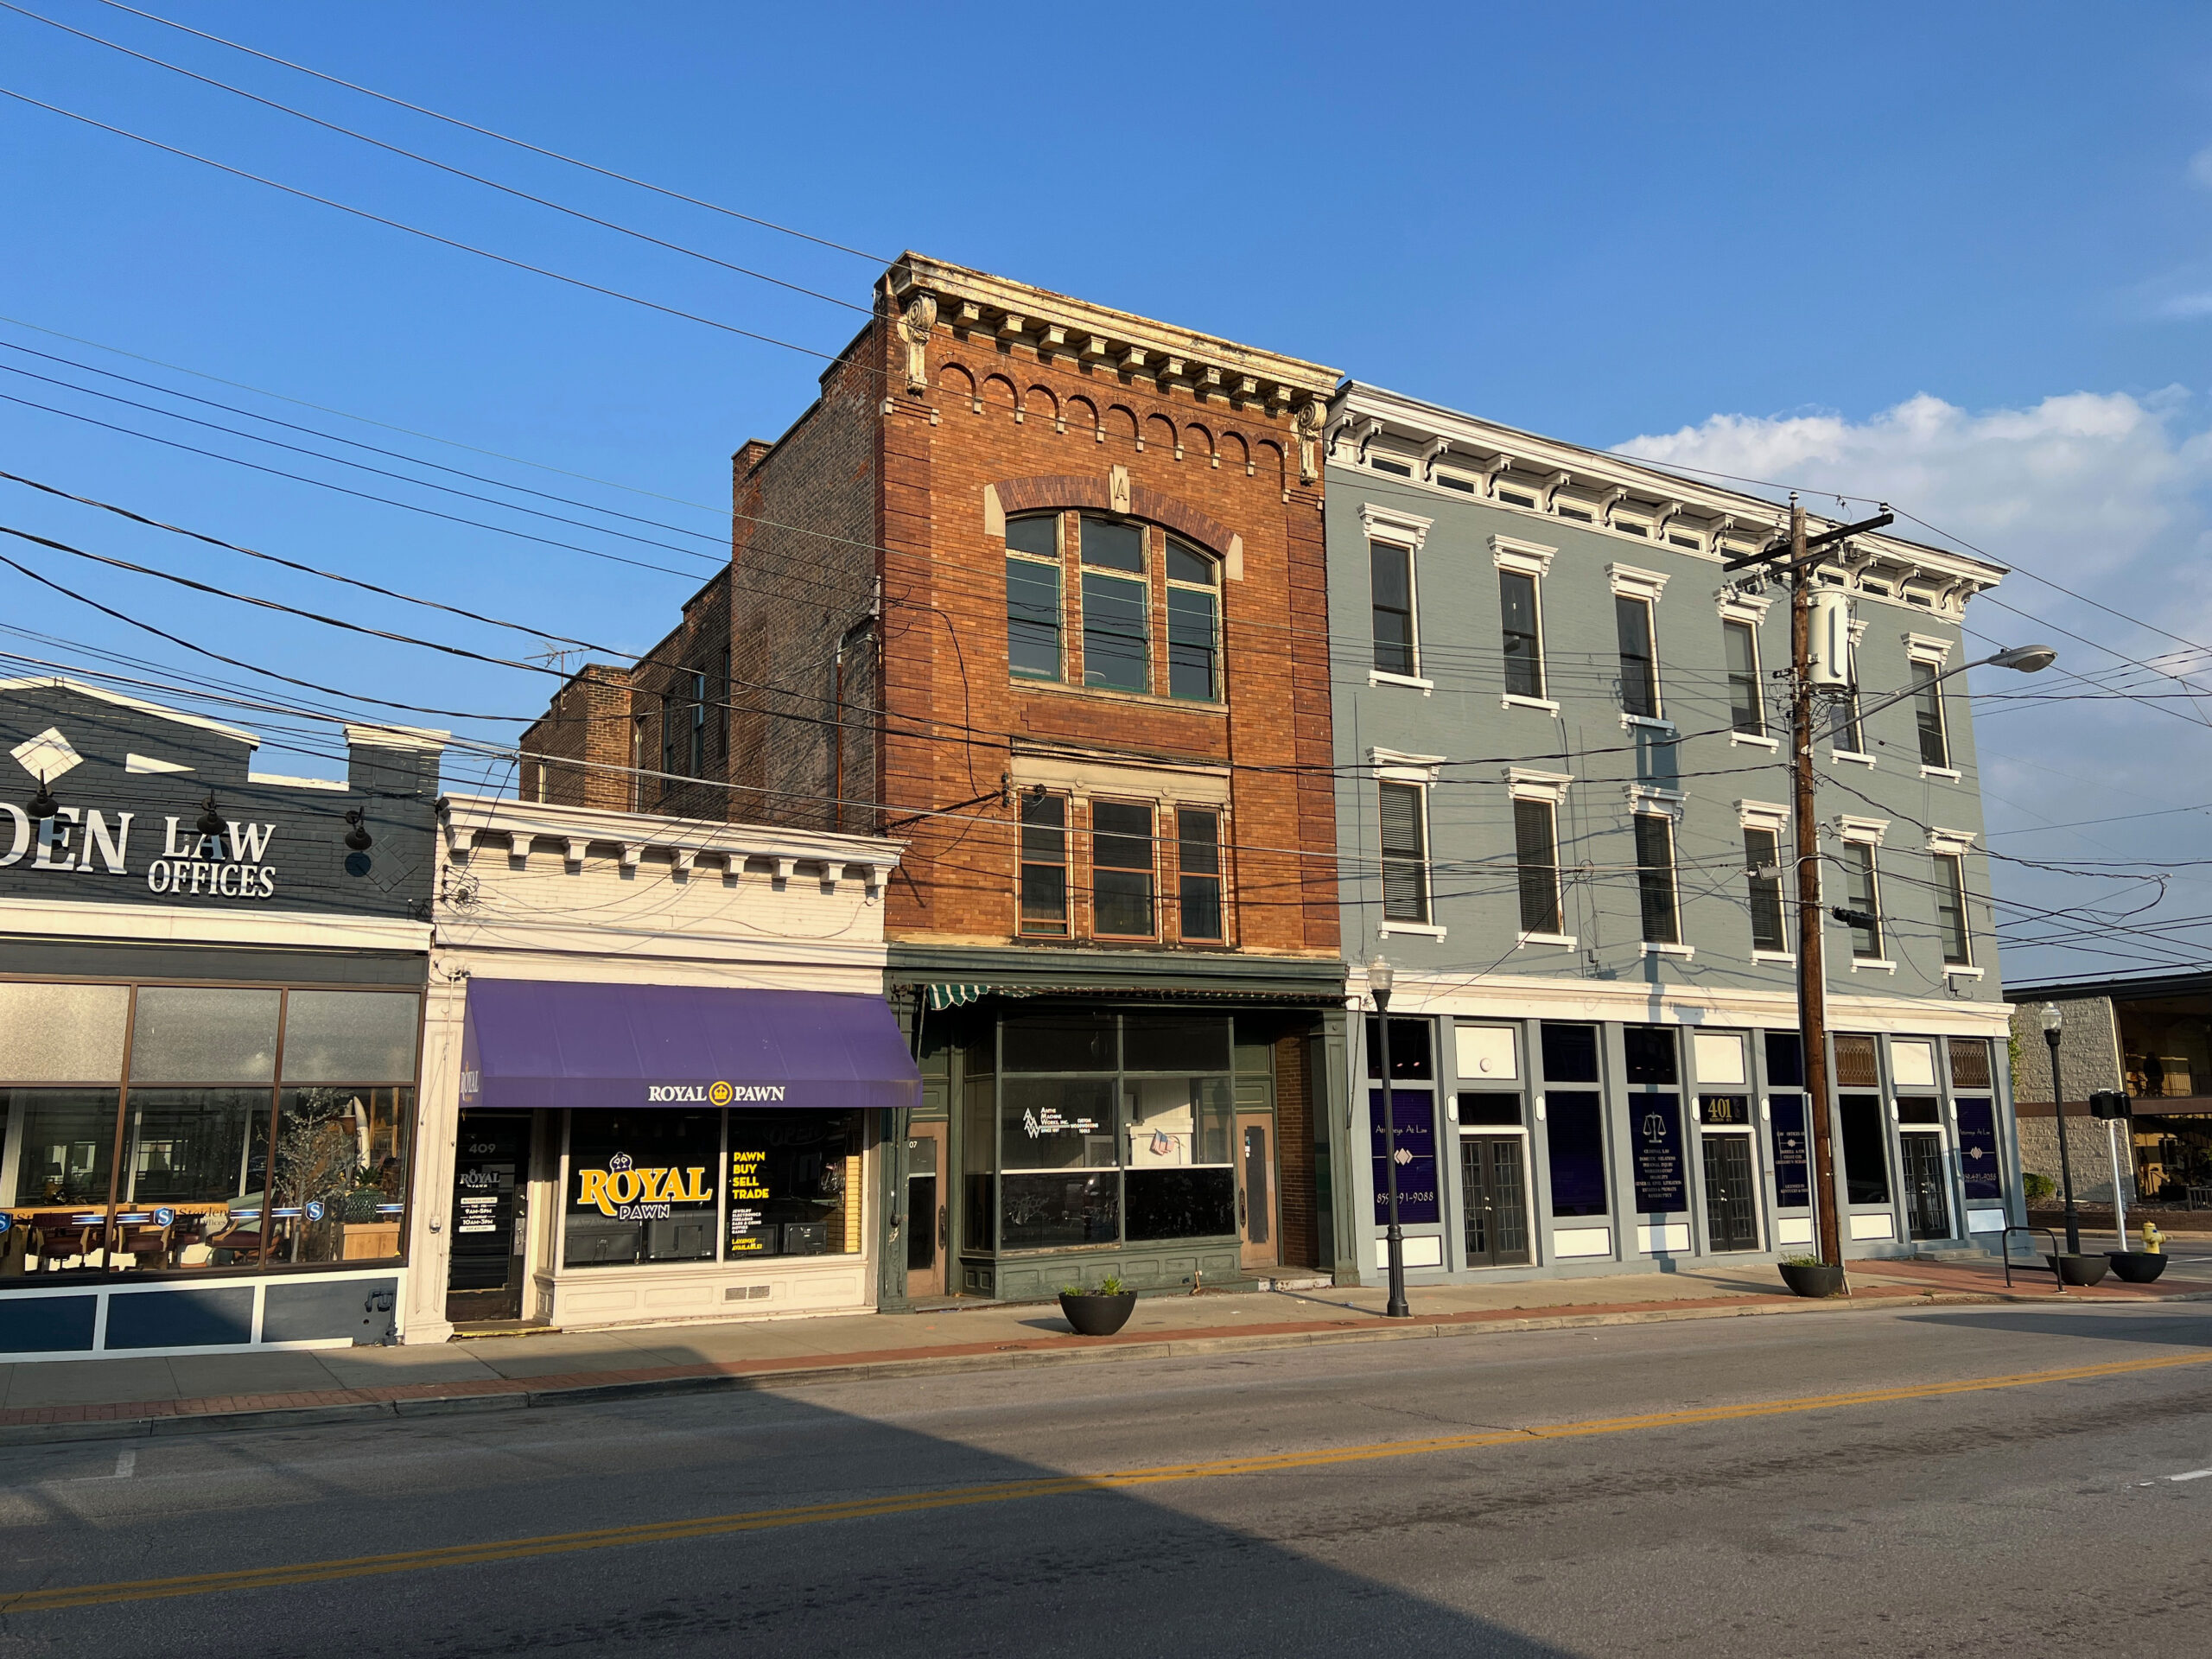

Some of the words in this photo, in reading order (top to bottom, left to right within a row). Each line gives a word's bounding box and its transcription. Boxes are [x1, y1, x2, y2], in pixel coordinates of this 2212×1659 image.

[1115, 477, 1128, 501] A
[162, 816, 276, 863] LAW
[148, 860, 276, 899] OFFICES
[648, 1085, 707, 1102] ROYAL
[734, 1085, 785, 1102] PAWN
[1707, 1098, 1732, 1118] 401
[1406, 1124, 1414, 1134] At
[1415, 1124, 1427, 1134] Law
[468, 1143, 496, 1154] 409
[734, 1151, 766, 1161] PAWN
[733, 1164, 757, 1174] BUY
[460, 1173, 500, 1187] ROYAL
[733, 1176, 760, 1186] SELL
[577, 1167, 713, 1216] ROYAL
[732, 1188, 769, 1199] TRADE
[157, 1211, 170, 1224] S
[309, 1205, 320, 1217] S
[620, 1205, 670, 1220] PAWN
